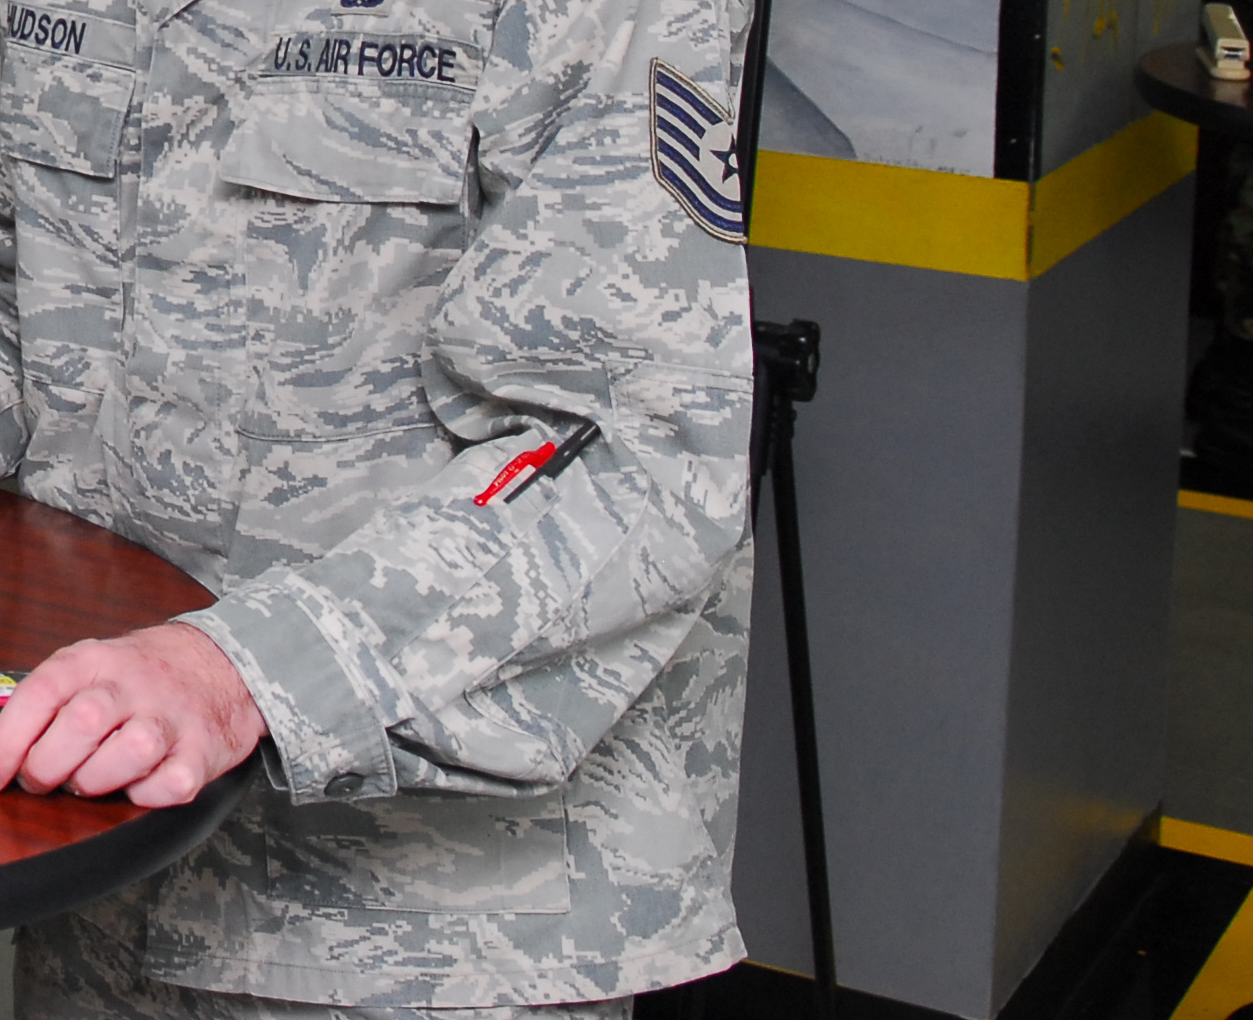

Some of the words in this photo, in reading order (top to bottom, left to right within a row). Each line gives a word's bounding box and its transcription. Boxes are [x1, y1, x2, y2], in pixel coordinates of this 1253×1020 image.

[274, 36, 312, 73] U.S.
[315, 37, 352, 75] AIR
[357, 40, 457, 83] FORCE
